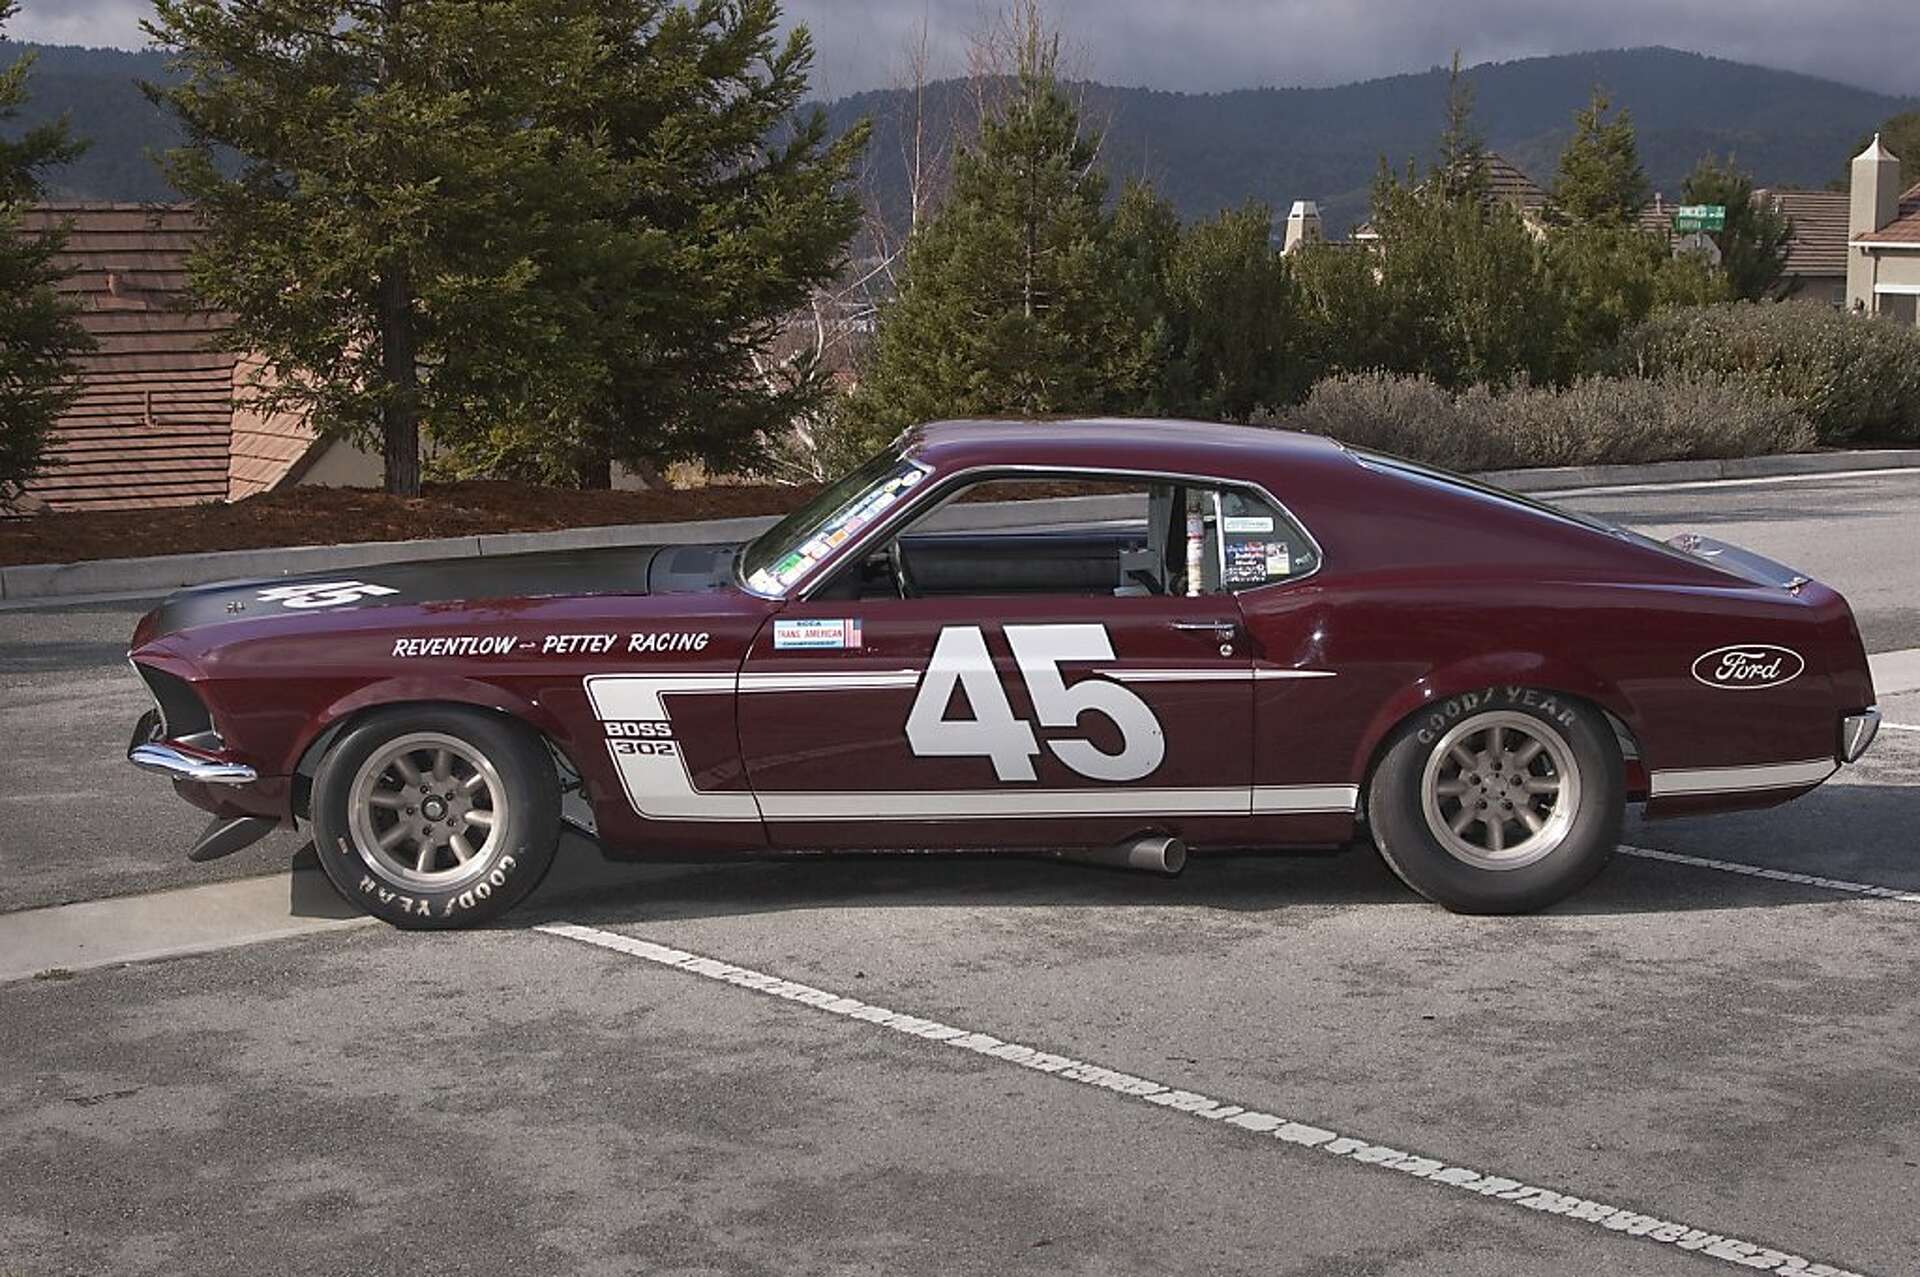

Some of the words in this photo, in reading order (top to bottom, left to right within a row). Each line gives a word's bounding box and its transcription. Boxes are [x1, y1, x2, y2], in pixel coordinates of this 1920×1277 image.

[257, 581, 400, 608] 45
[392, 637, 517, 657] REVENTLOW
[542, 634, 617, 654] PETTEY
[628, 632, 709, 652] RACING
[777, 630, 801, 639] TRANS
[803, 629, 843, 639] AMERICAN
[1715, 651, 1782, 680] Ford
[905, 624, 1165, 781] 45
[604, 722, 672, 737] BOSS
[616, 742, 675, 756] 302
